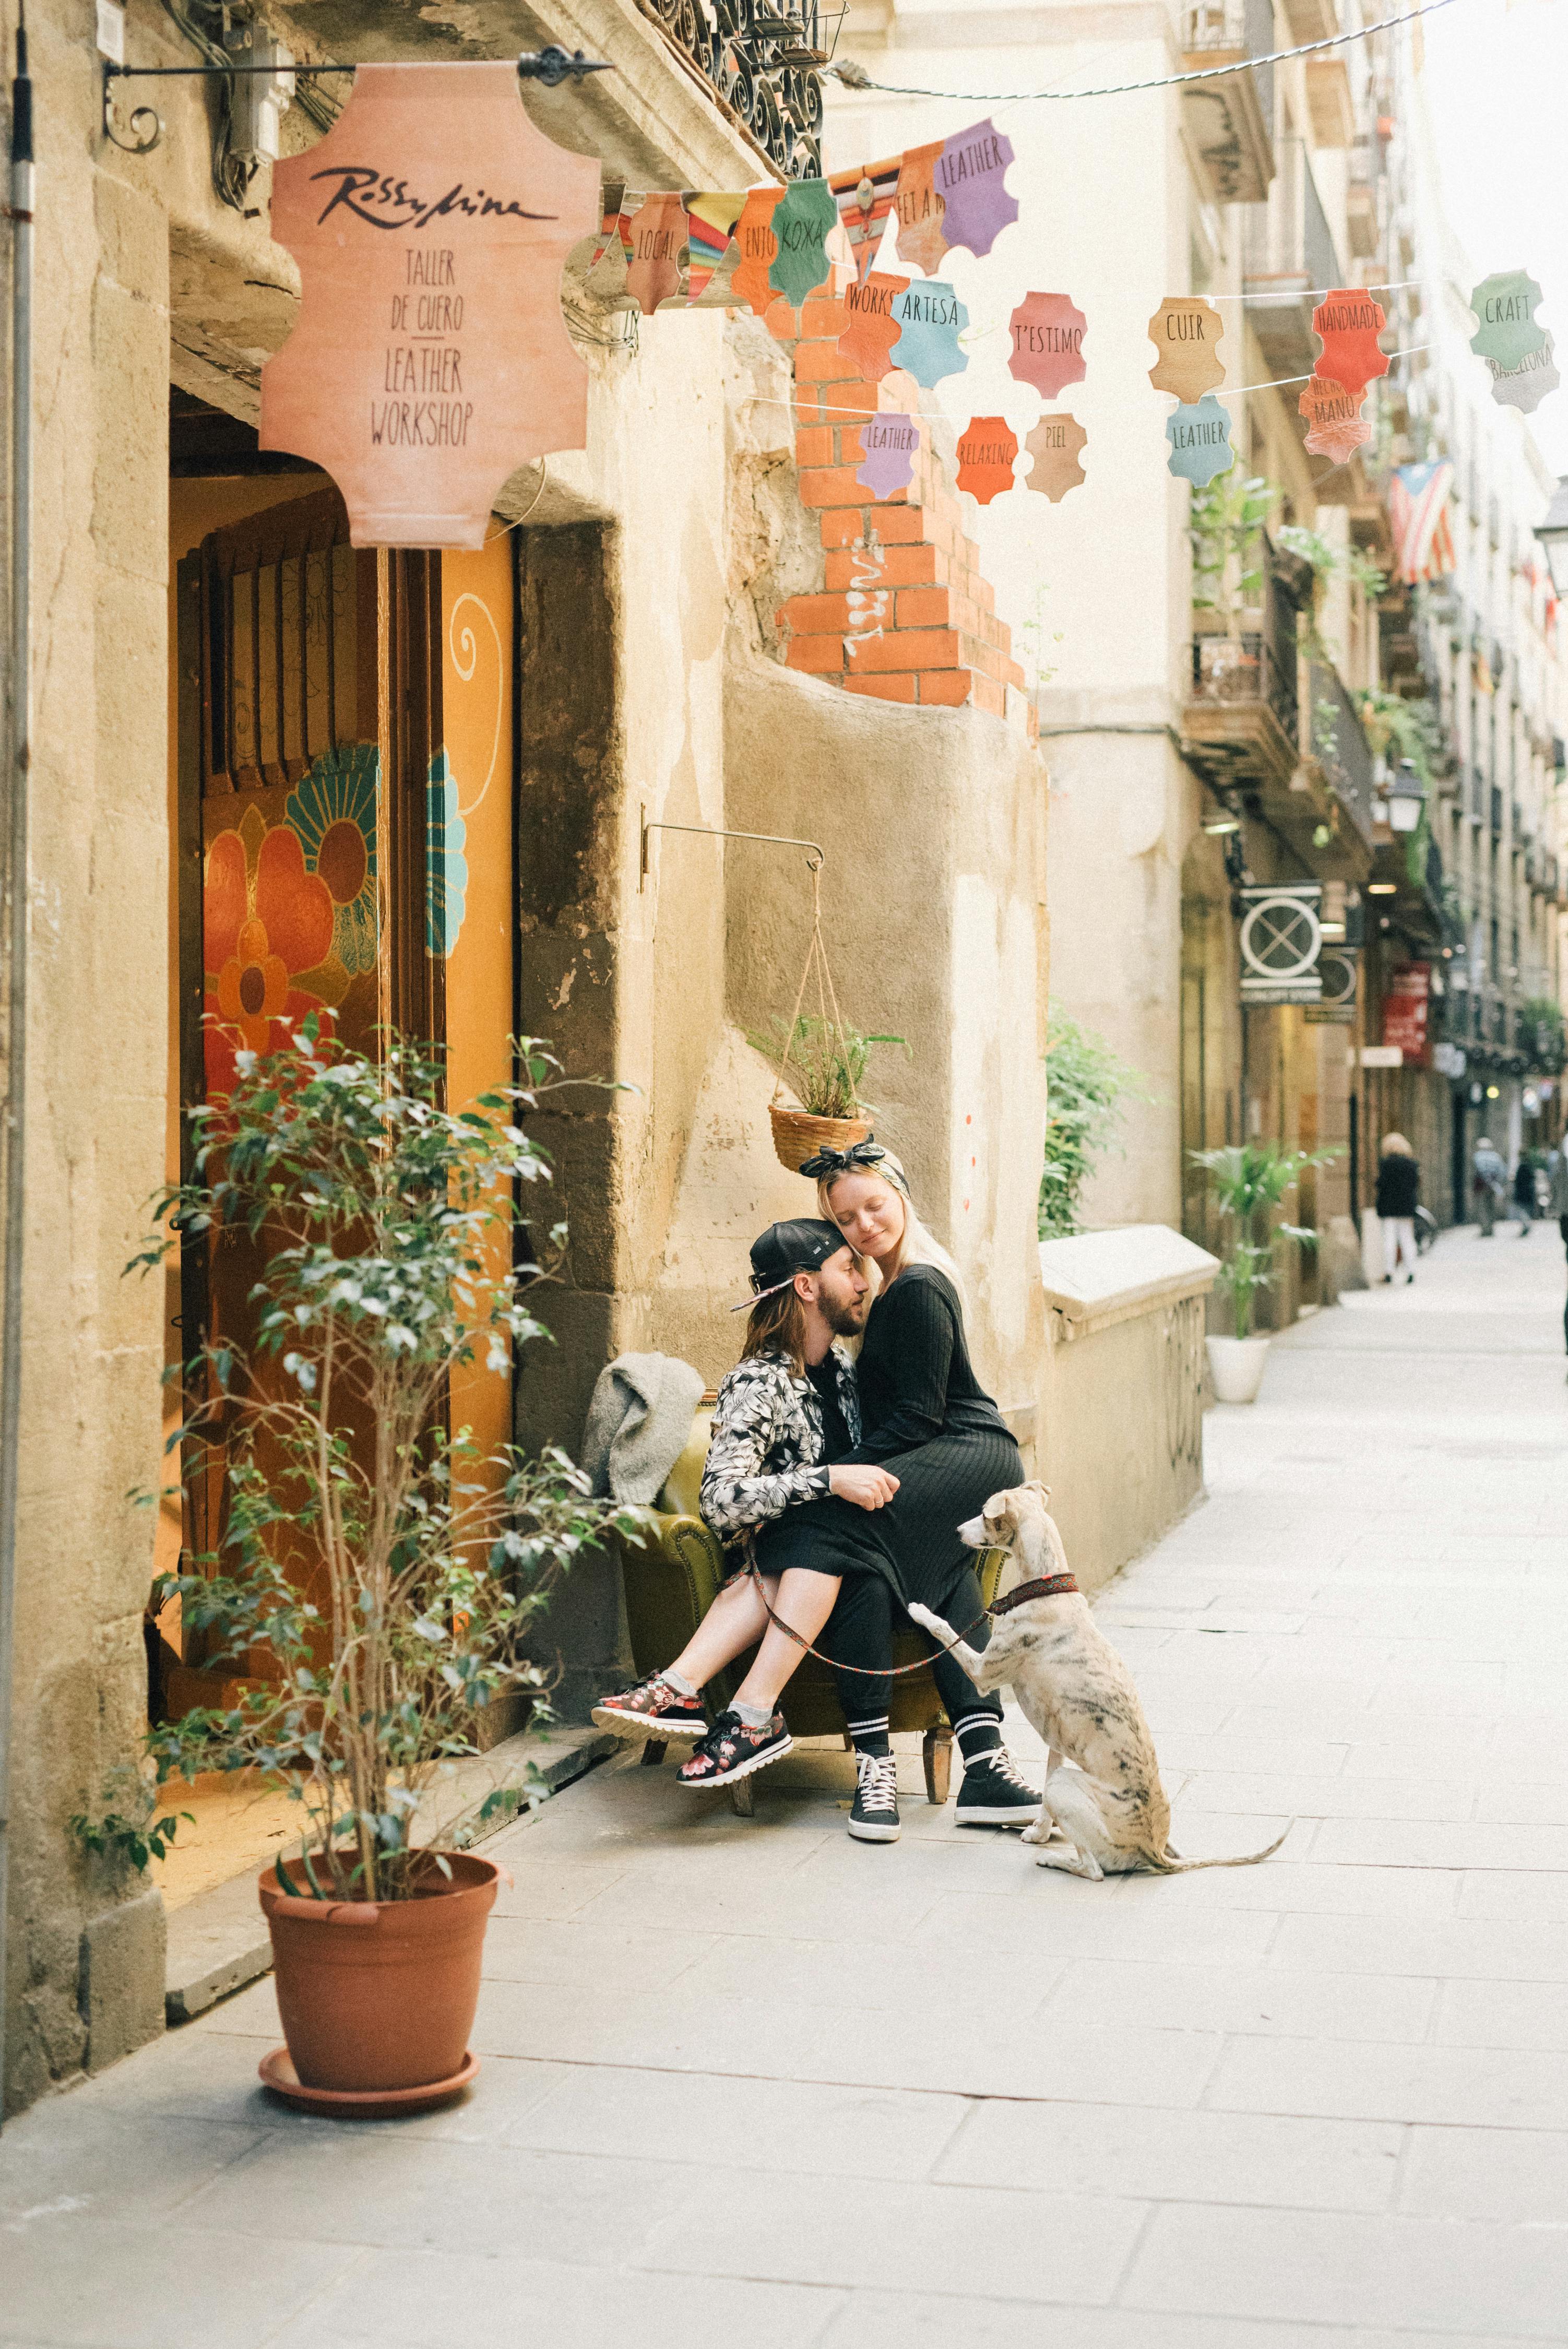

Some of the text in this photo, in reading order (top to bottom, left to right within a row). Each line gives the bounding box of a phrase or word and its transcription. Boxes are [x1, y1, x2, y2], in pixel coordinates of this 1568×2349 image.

[941, 136, 1004, 188] LEATHER
[897, 191, 916, 227] FET
[935, 193, 946, 215] M
[637, 229, 674, 261] LOCAL
[746, 226, 774, 260] ENJO
[406, 249, 455, 286] TALLER
[390, 294, 465, 331] DE CUERO
[850, 283, 894, 316] WORKS
[902, 294, 958, 325] ARTESÀ
[1486, 295, 1529, 323] CRAFT
[1167, 314, 1205, 341] CUIR
[1318, 304, 1381, 332] HANDMADE
[384, 347, 462, 393] LEATHER
[371, 401, 473, 447] WORKSHOP
[1314, 396, 1355, 424] MANO
[867, 426, 913, 450] LEATHER
[1046, 425, 1066, 448] PIEL
[1173, 421, 1226, 449] LEATHER
[960, 443, 1013, 465] RELAXING
